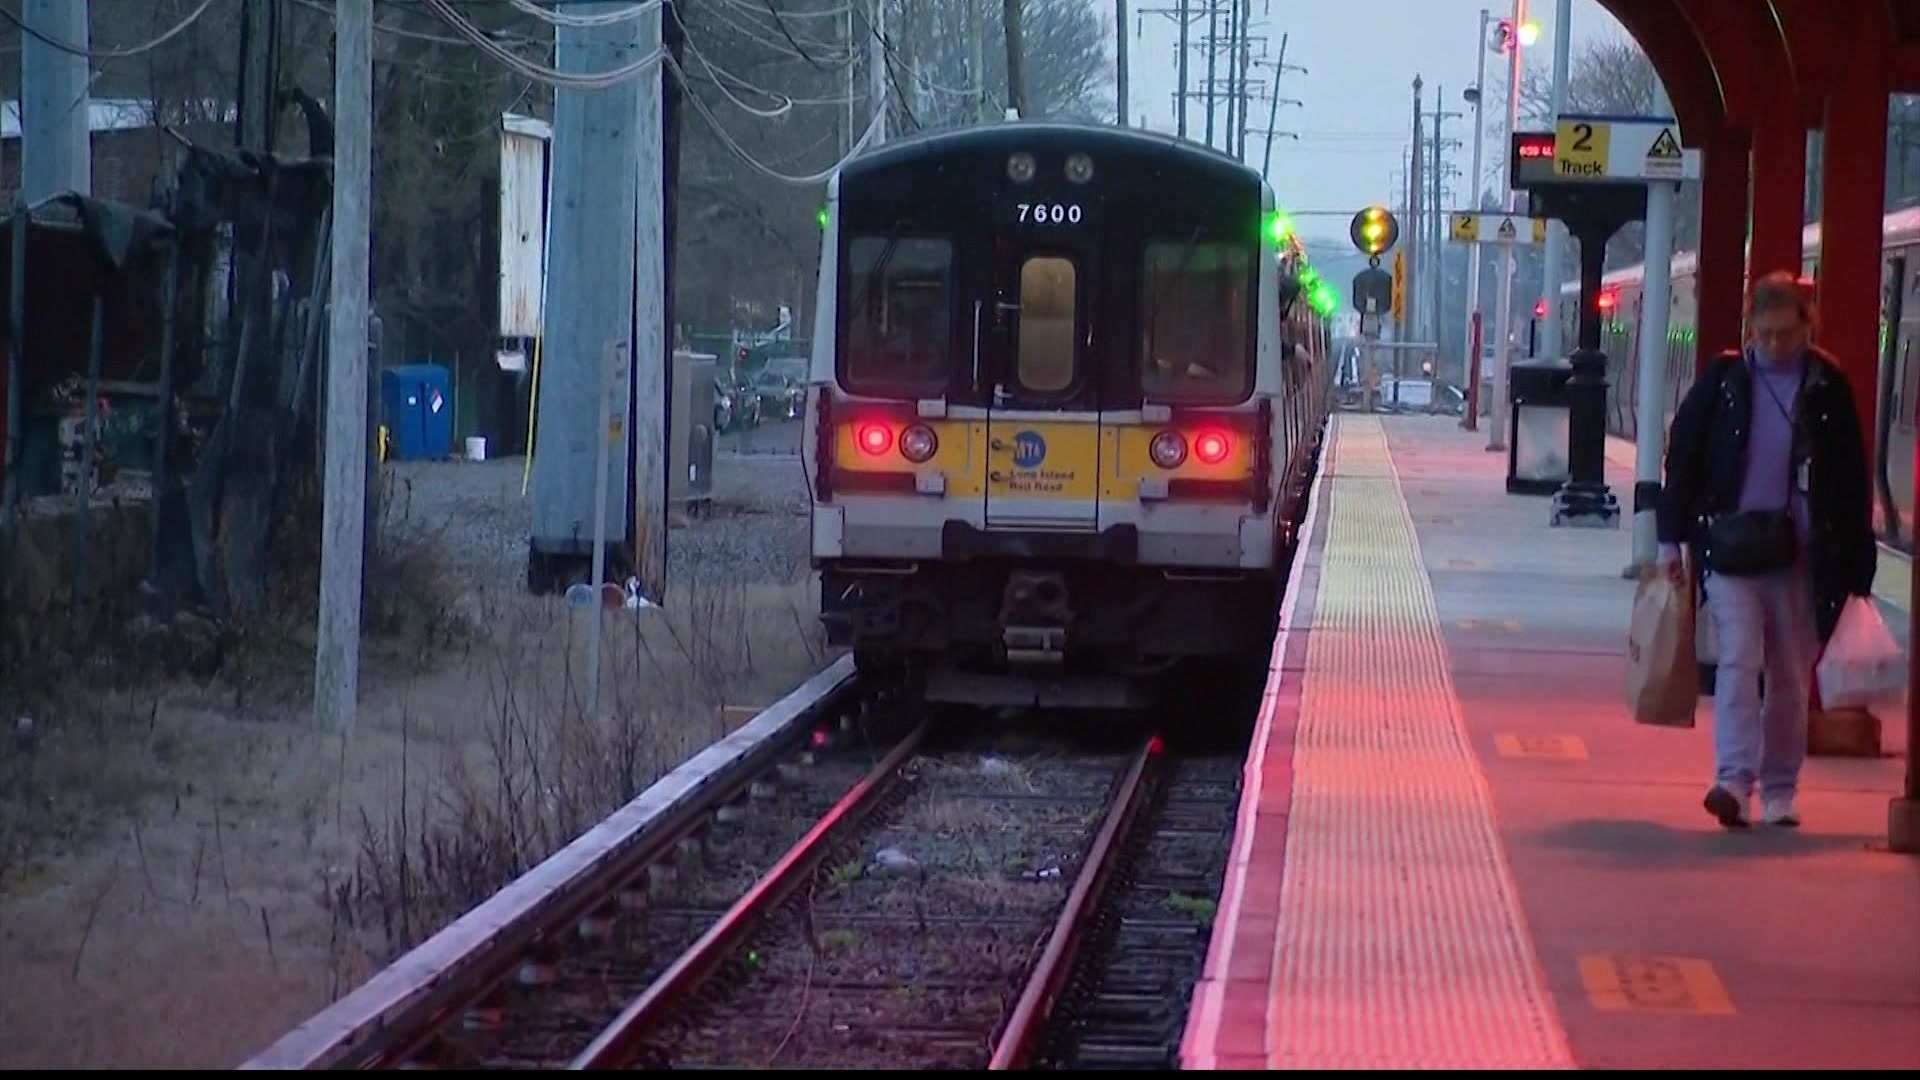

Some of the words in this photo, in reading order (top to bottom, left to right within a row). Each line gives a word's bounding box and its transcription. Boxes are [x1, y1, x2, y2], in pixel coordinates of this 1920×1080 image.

[1572, 123, 1593, 151] 2
[1559, 159, 1603, 175] Track
[1017, 203, 1082, 223] 7600
